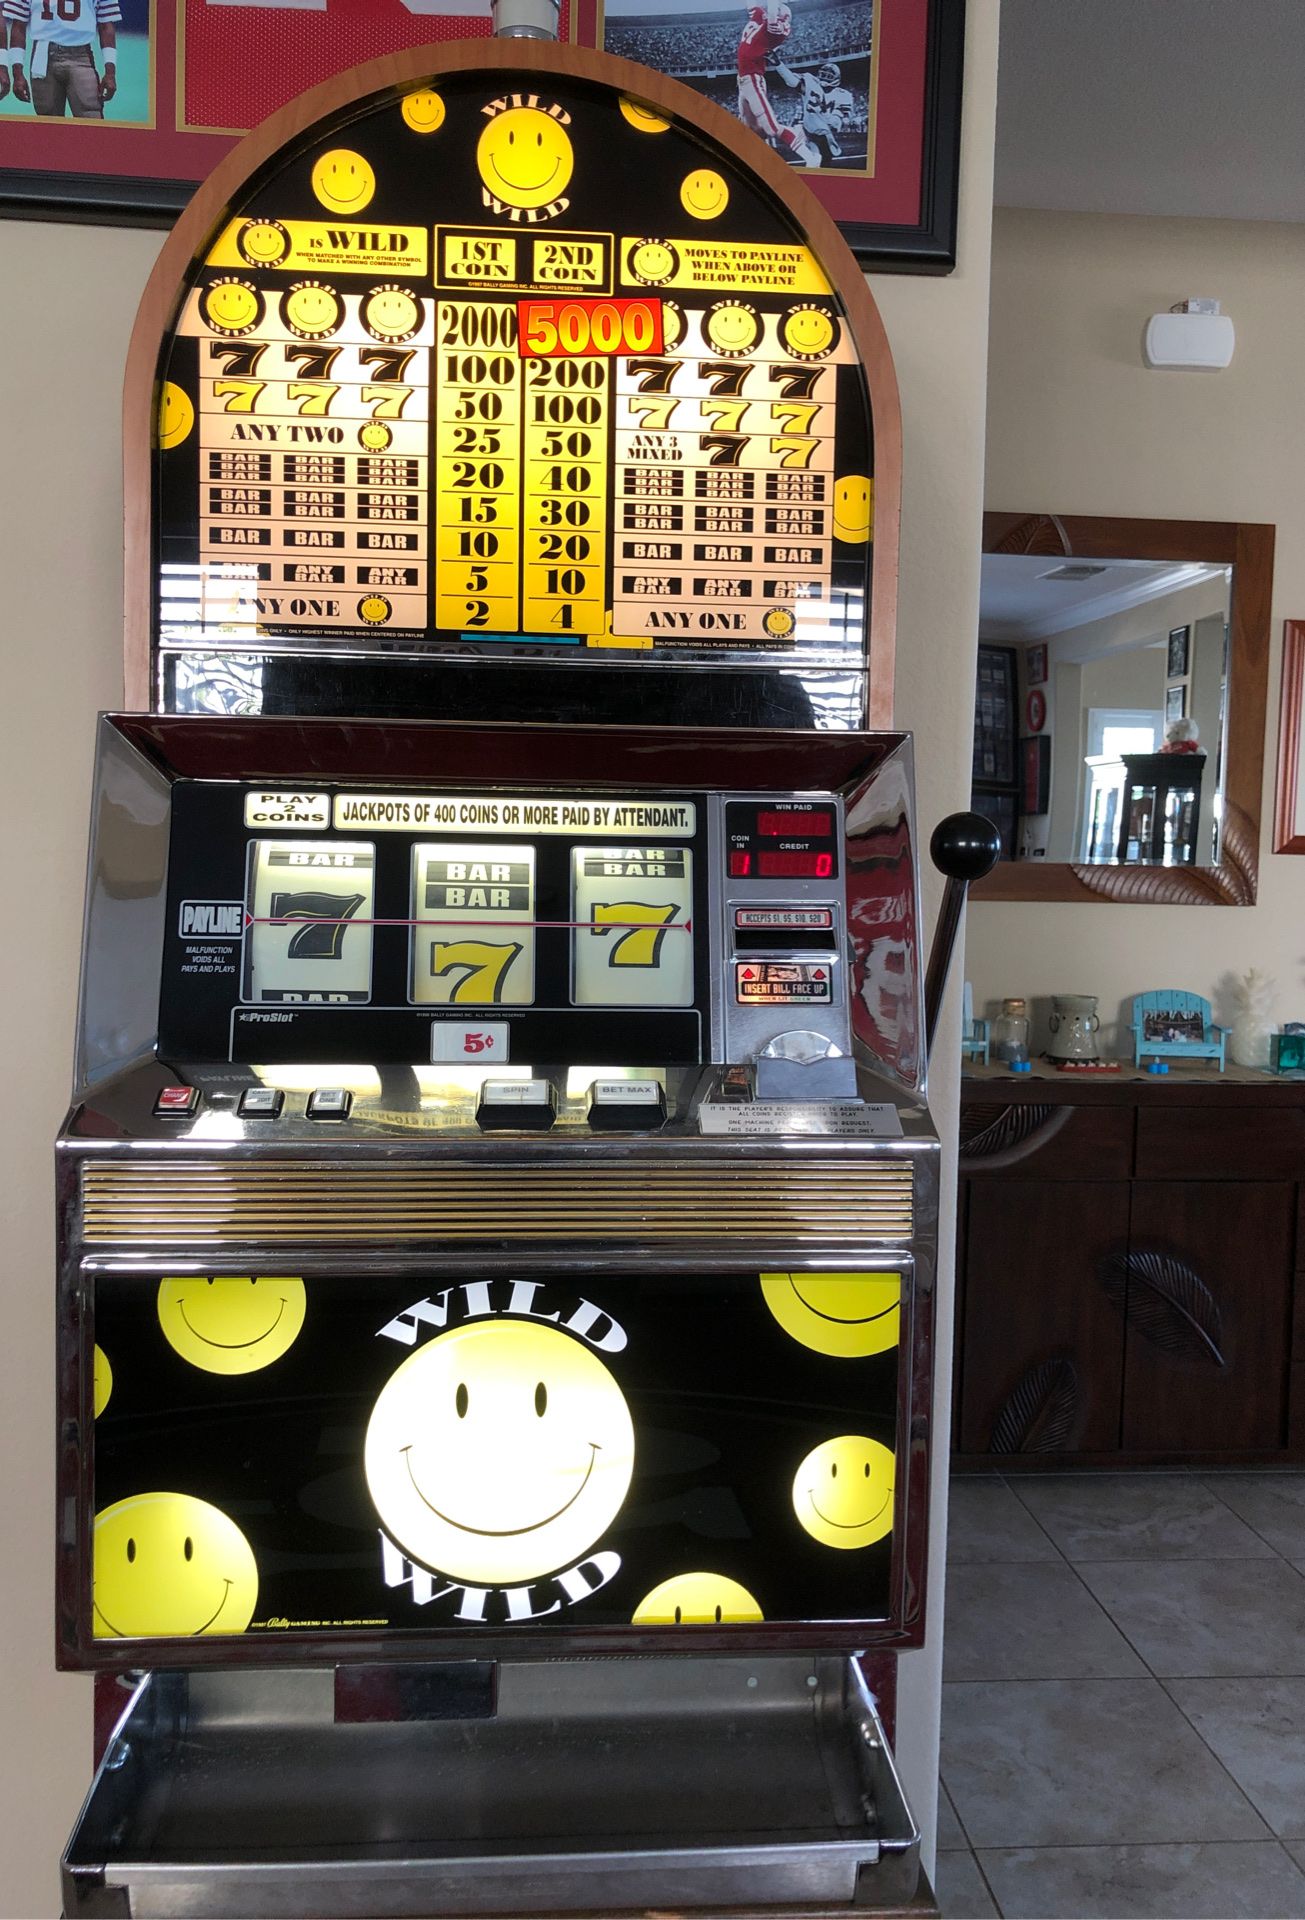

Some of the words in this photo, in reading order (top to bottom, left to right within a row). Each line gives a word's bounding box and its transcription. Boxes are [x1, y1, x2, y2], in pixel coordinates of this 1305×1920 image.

[480, 94, 571, 124] WILD
[482, 186, 570, 222] WILD
[309, 239, 323, 248] IS
[326, 230, 409, 252] WILD
[461, 241, 502, 261] 1ST
[544, 245, 593, 265] 2ND
[685, 248, 728, 258] MOVES
[730, 250, 747, 259] TO
[750, 251, 804, 262] PAYLINE
[450, 263, 509, 276] COIN
[539, 267, 596, 280] COIN
[692, 260, 730, 271] WHEN
[734, 263, 776, 272] ABOVE
[778, 264, 797, 273] OR
[209, 276, 256, 291] WILD
[693, 272, 738, 282] BELOW
[742, 275, 795, 285] PAYLINE
[289, 281, 336, 295] WILD
[369, 284, 416, 298] WILD
[711, 300, 756, 314] WILD
[787, 303, 832, 318] WILD
[209, 320, 256, 336] WILD
[290, 323, 336, 339] WILD
[370, 326, 415, 343] WILD
[442, 304, 518, 348] 2000
[526, 303, 655, 354] 5000
[711, 341, 755, 357] WILD
[787, 345, 831, 361] WILD
[445, 355, 515, 385] 100
[529, 358, 605, 389] 200
[455, 392, 502, 420] 50
[532, 395, 601, 424] 100
[230, 423, 281, 441] ANY
[287, 425, 344, 444] TWO
[453, 427, 501, 454] 25
[632, 435, 666, 447] ANY
[669, 436, 678, 448] 3
[541, 431, 591, 458] 50
[627, 448, 683, 461] MIXED
[452, 462, 504, 488] 20
[539, 466, 591, 492] 40
[221, 489, 260, 501] BAR
[295, 492, 334, 503] BAR
[369, 495, 408, 506] BAR
[221, 503, 260, 514] BAR
[295, 506, 334, 516] BAR
[369, 508, 408, 519] BAR
[458, 497, 498, 523] 15
[539, 500, 590, 526] 30
[221, 529, 260, 544] BAR
[295, 532, 334, 546] BAR
[368, 534, 407, 549] BAR
[457, 532, 498, 557] 10
[539, 534, 590, 561] 20
[634, 544, 672, 558] BAR
[705, 546, 742, 561] BAR
[775, 548, 812, 563] BAR
[466, 566, 488, 592] 5
[545, 569, 585, 595] 10
[290, 599, 340, 617] ONE
[465, 601, 490, 626] 2
[550, 604, 575, 629] 4
[645, 611, 693, 628] ANY
[699, 613, 746, 630] ONE
[261, 795, 318, 804] PLAY
[252, 813, 325, 822] COINS
[343, 802, 410, 822] JACKPOTS
[414, 804, 430, 822] OF
[434, 804, 456, 823] 400
[460, 805, 498, 824] COINS
[503, 806, 519, 824] OR
[524, 806, 558, 825] MORE
[562, 808, 590, 826] PAID
[594, 808, 609, 826] BY
[614, 808, 688, 828] ATTENDANT.
[288, 852, 355, 866] BAR
[743, 855, 749, 875] 1
[816, 854, 832, 877] 0
[446, 863, 510, 882] BAR
[604, 864, 666, 876] BAR
[446, 888, 510, 908] BAR
[184, 906, 241, 933] PAYLINE
[270, 891, 367, 959] 7
[746, 914, 771, 922] ACCEPTS
[590, 902, 681, 968] 7
[185, 946, 233, 954] MALFUNCTION
[199, 965, 213, 973] AND
[214, 965, 235, 973] PLAYS
[430, 940, 524, 1003] 7
[745, 984, 771, 994] INSERT
[773, 984, 790, 994] BILL
[793, 984, 811, 994] FACE
[814, 984, 824, 994] UP
[464, 1033, 494, 1053] 5¢
[374, 1280, 628, 1353] WILD
[378, 1528, 622, 1622] WILD
